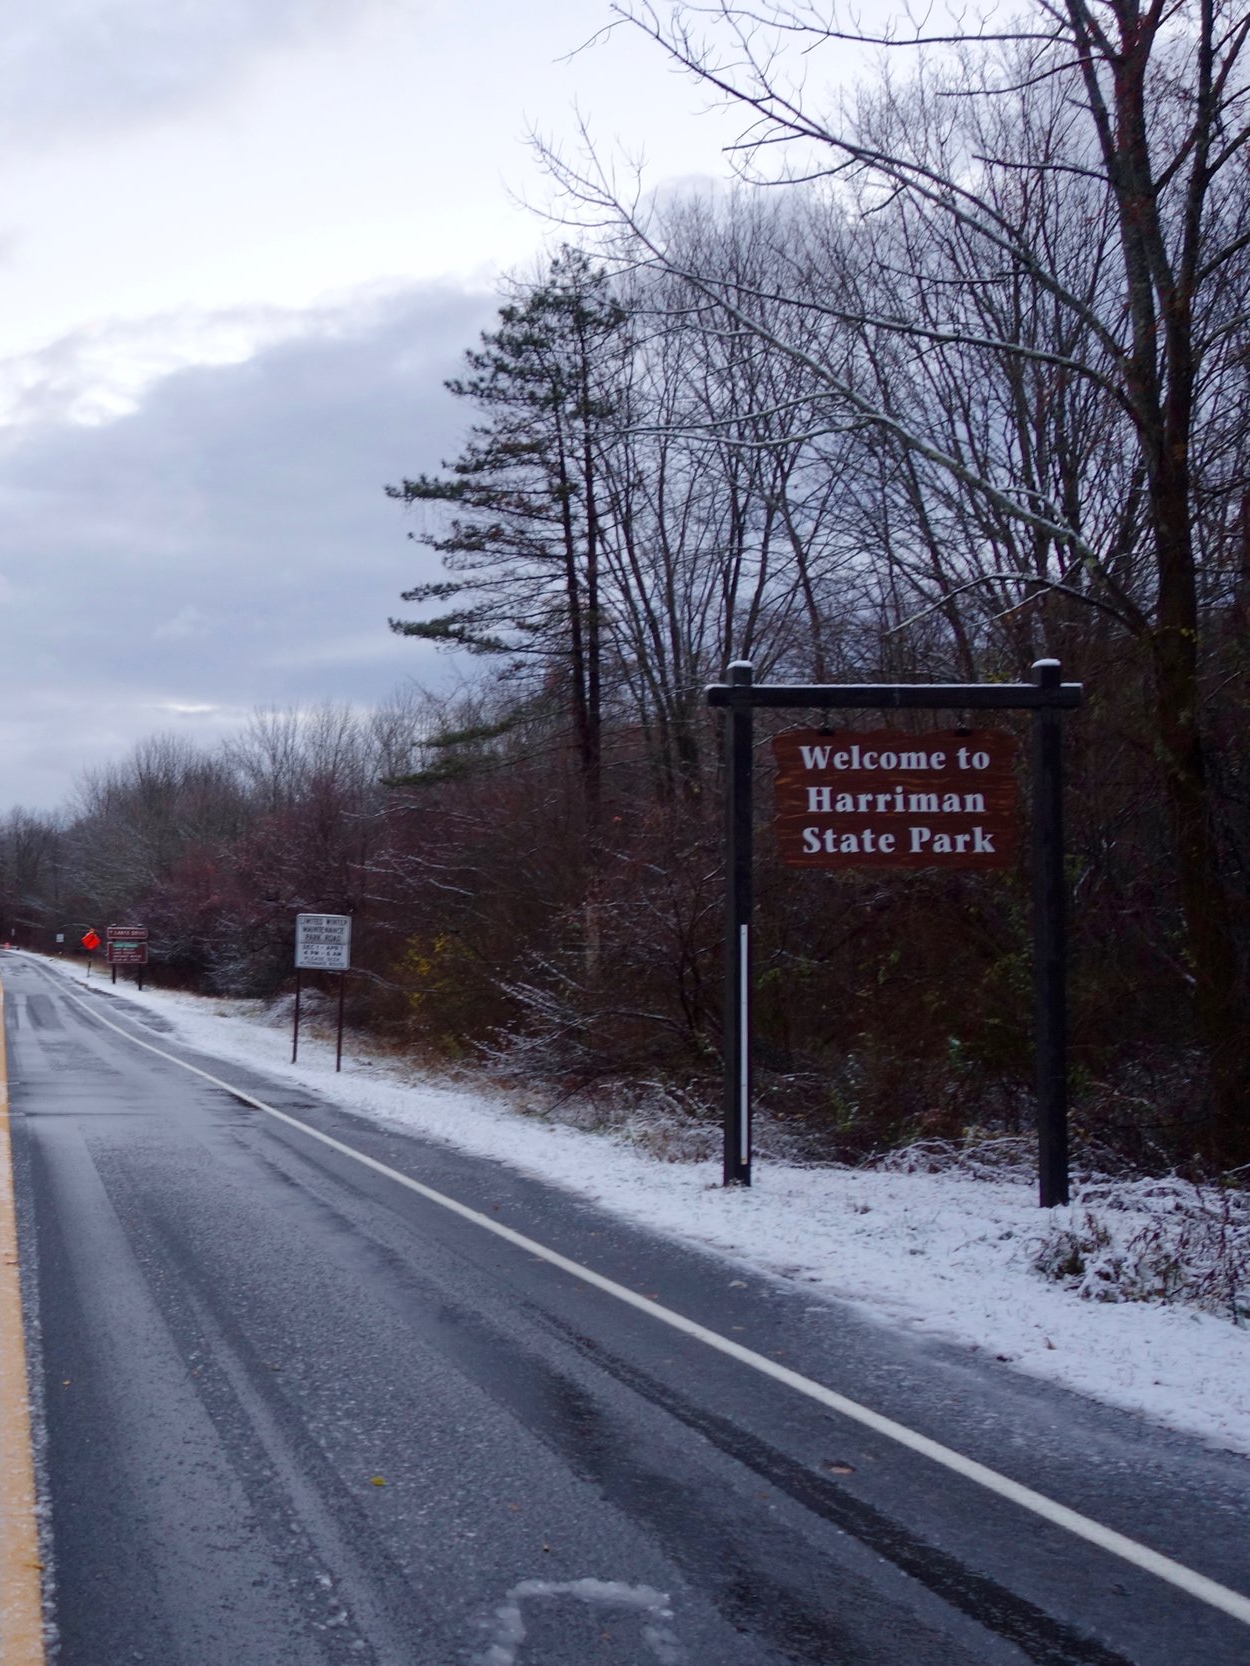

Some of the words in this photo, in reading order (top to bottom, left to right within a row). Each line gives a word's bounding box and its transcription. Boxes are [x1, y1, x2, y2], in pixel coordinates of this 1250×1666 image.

[799, 745, 946, 770] Welcome
[956, 747, 991, 770] to
[806, 786, 987, 813] Harriman
[802, 827, 896, 853] State
[909, 827, 996, 853] Park
[303, 926, 345, 934] MAINTENANCE
[324, 934, 342, 942] ROAD
